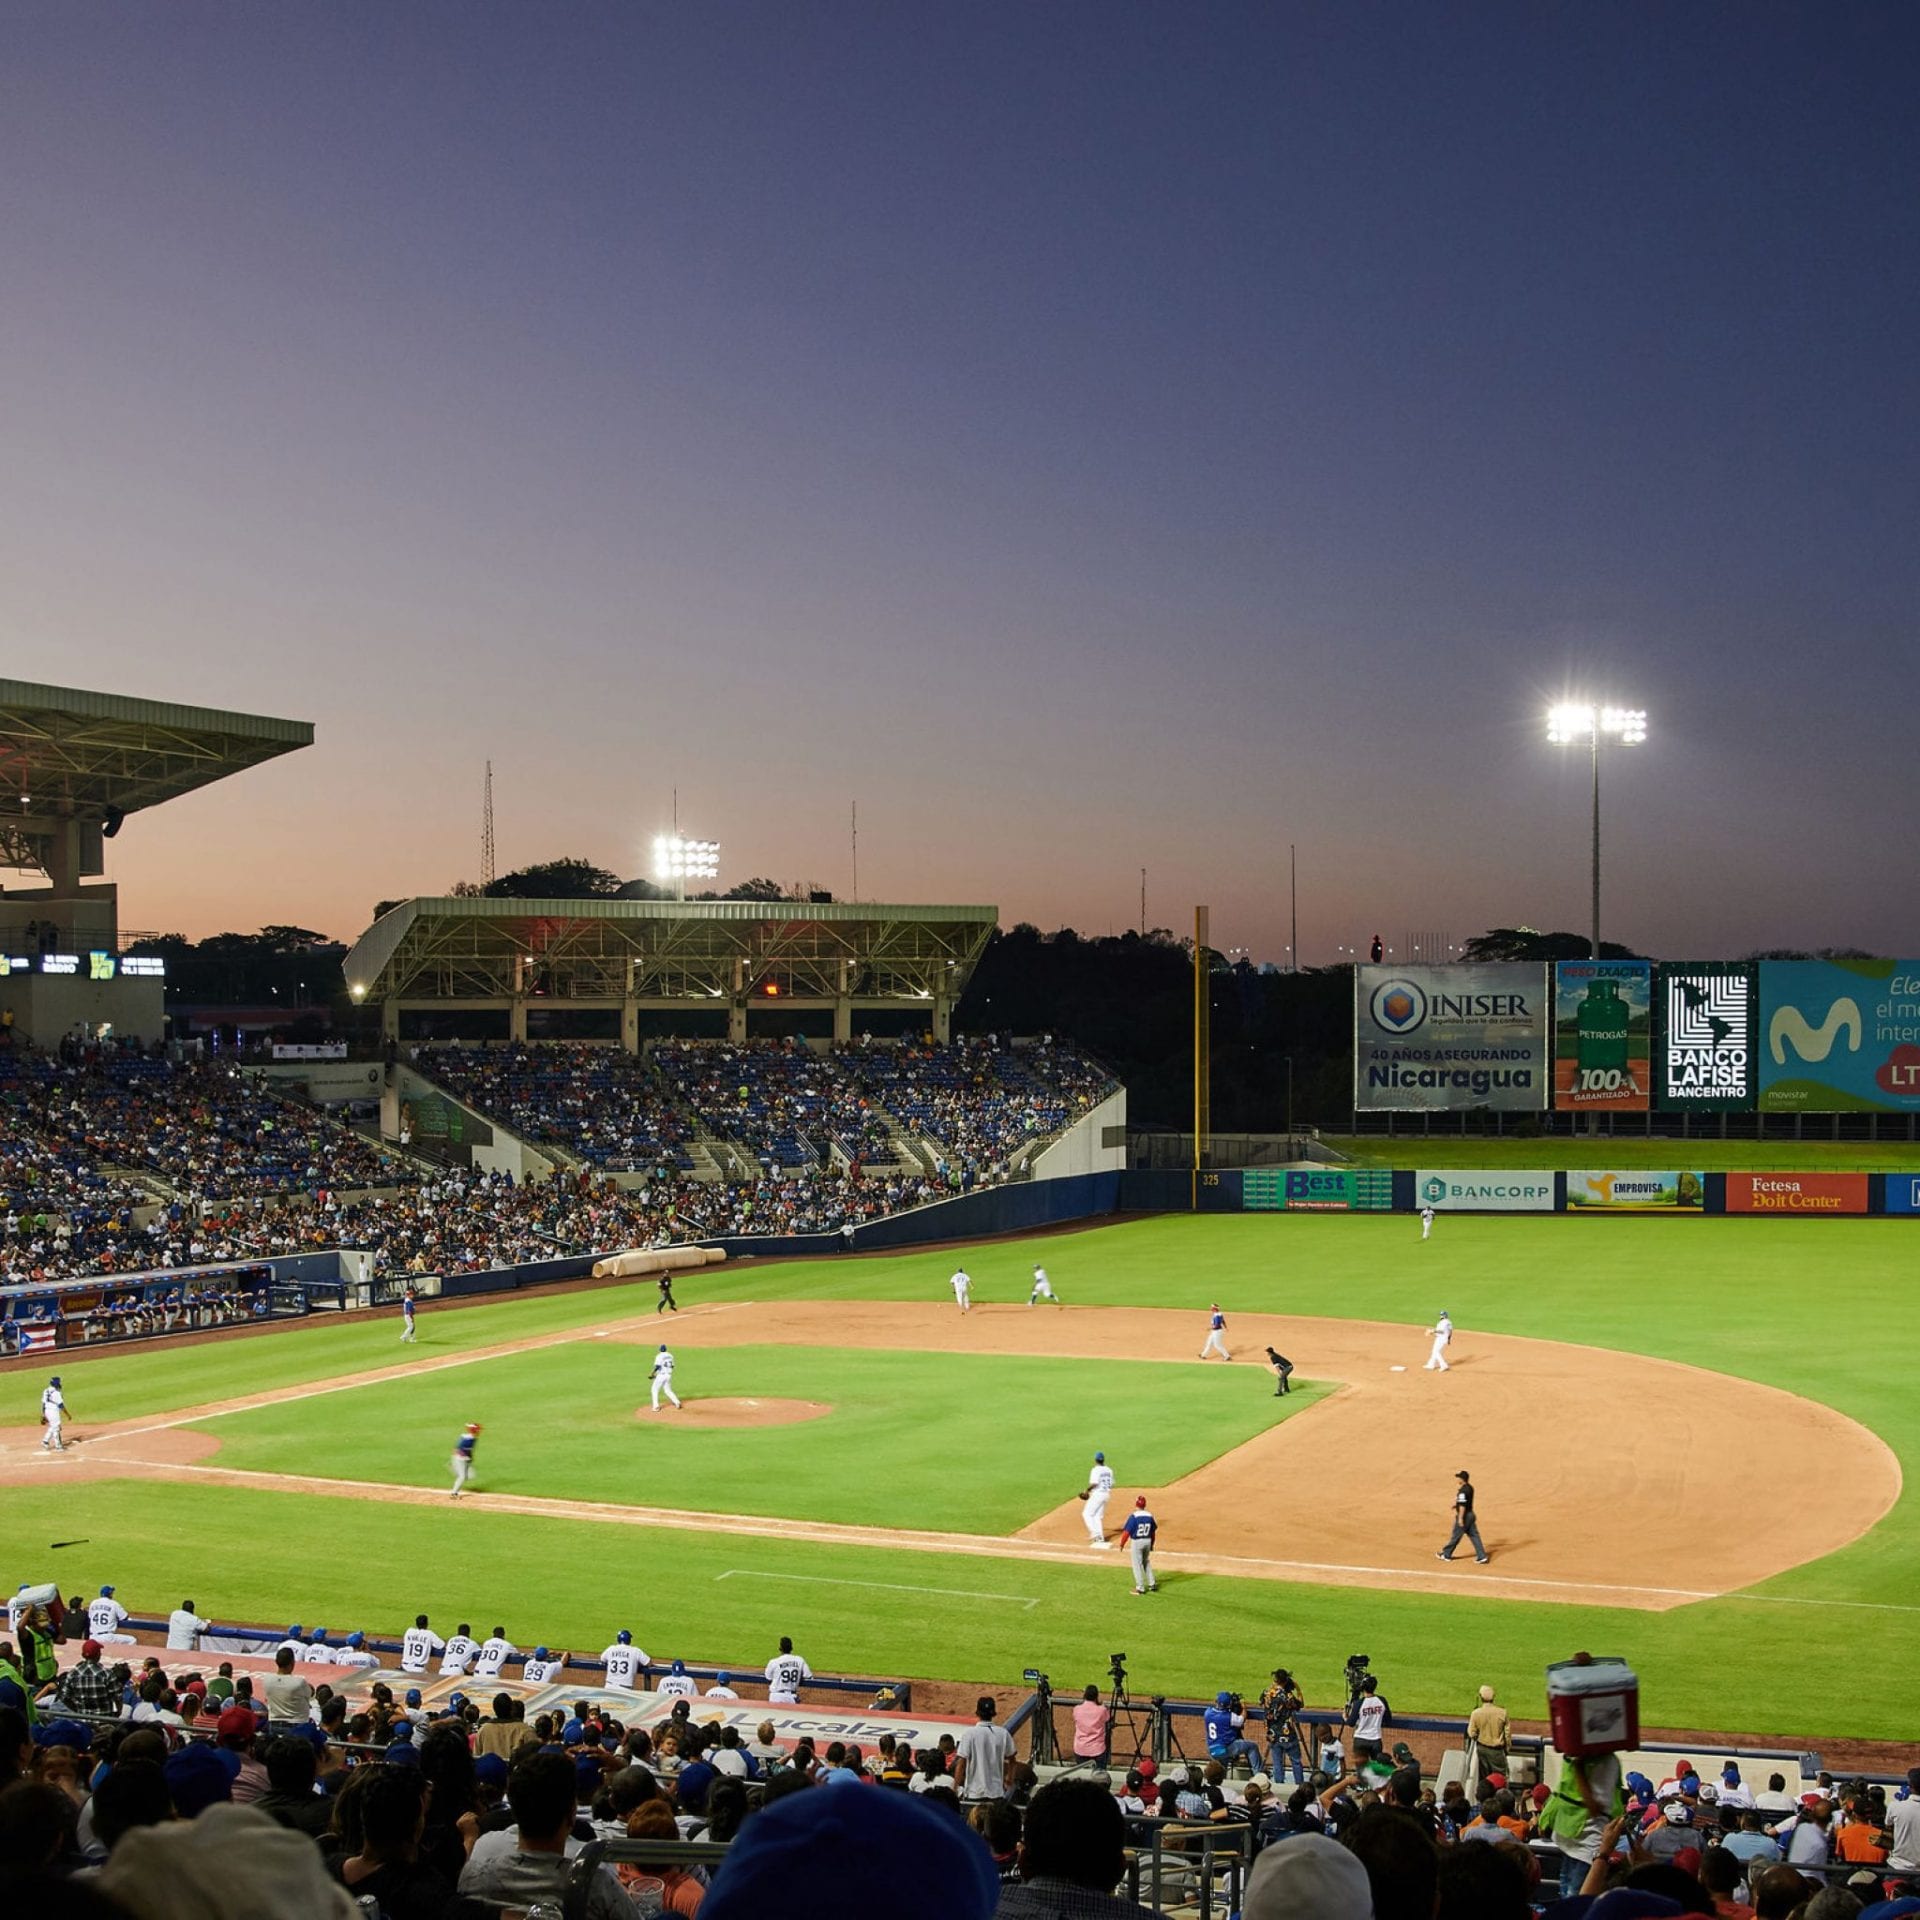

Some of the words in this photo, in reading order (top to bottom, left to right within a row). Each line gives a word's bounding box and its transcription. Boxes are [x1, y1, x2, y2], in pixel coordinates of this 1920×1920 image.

[1430, 993, 1533, 1018] INISER
[1876, 999, 1892, 1018] el
[1897, 1004, 1920, 1018] m
[1580, 1029, 1628, 1040] PETROGAS
[1371, 1050, 1388, 1061] 40
[1392, 1047, 1431, 1061] AÑOS
[1434, 1050, 1531, 1061] ASEGURANDO
[1668, 1050, 1747, 1066] BANCO
[1369, 1063, 1531, 1095] Nicaragua
[1668, 1066, 1747, 1086] LAFISE
[1574, 1091, 1631, 1101] GARANTIZADO
[1668, 1087, 1747, 1098] BANCENTRO
[1203, 1175, 1219, 1186] 325
[1286, 1172, 1345, 1198] Best
[1752, 1178, 1800, 1192] Fetesa
[1451, 1185, 1549, 1197] BANCORP
[1614, 1183, 1663, 1193] EMPROVISA
[1789, 1193, 1841, 1208] Center
[1136, 1523, 1151, 1537] 20
[92, 1613, 109, 1625] 46
[408, 1643, 424, 1657] 19
[448, 1644, 465, 1655] 36
[480, 1649, 499, 1661] 30
[525, 1668, 544, 1681] 29
[610, 1661, 629, 1674] 33
[781, 1669, 799, 1683] 98
[1362, 1705, 1383, 1717] STAFF
[727, 1713, 920, 1739] Lucalza
[1208, 1722, 1217, 1740] 6
